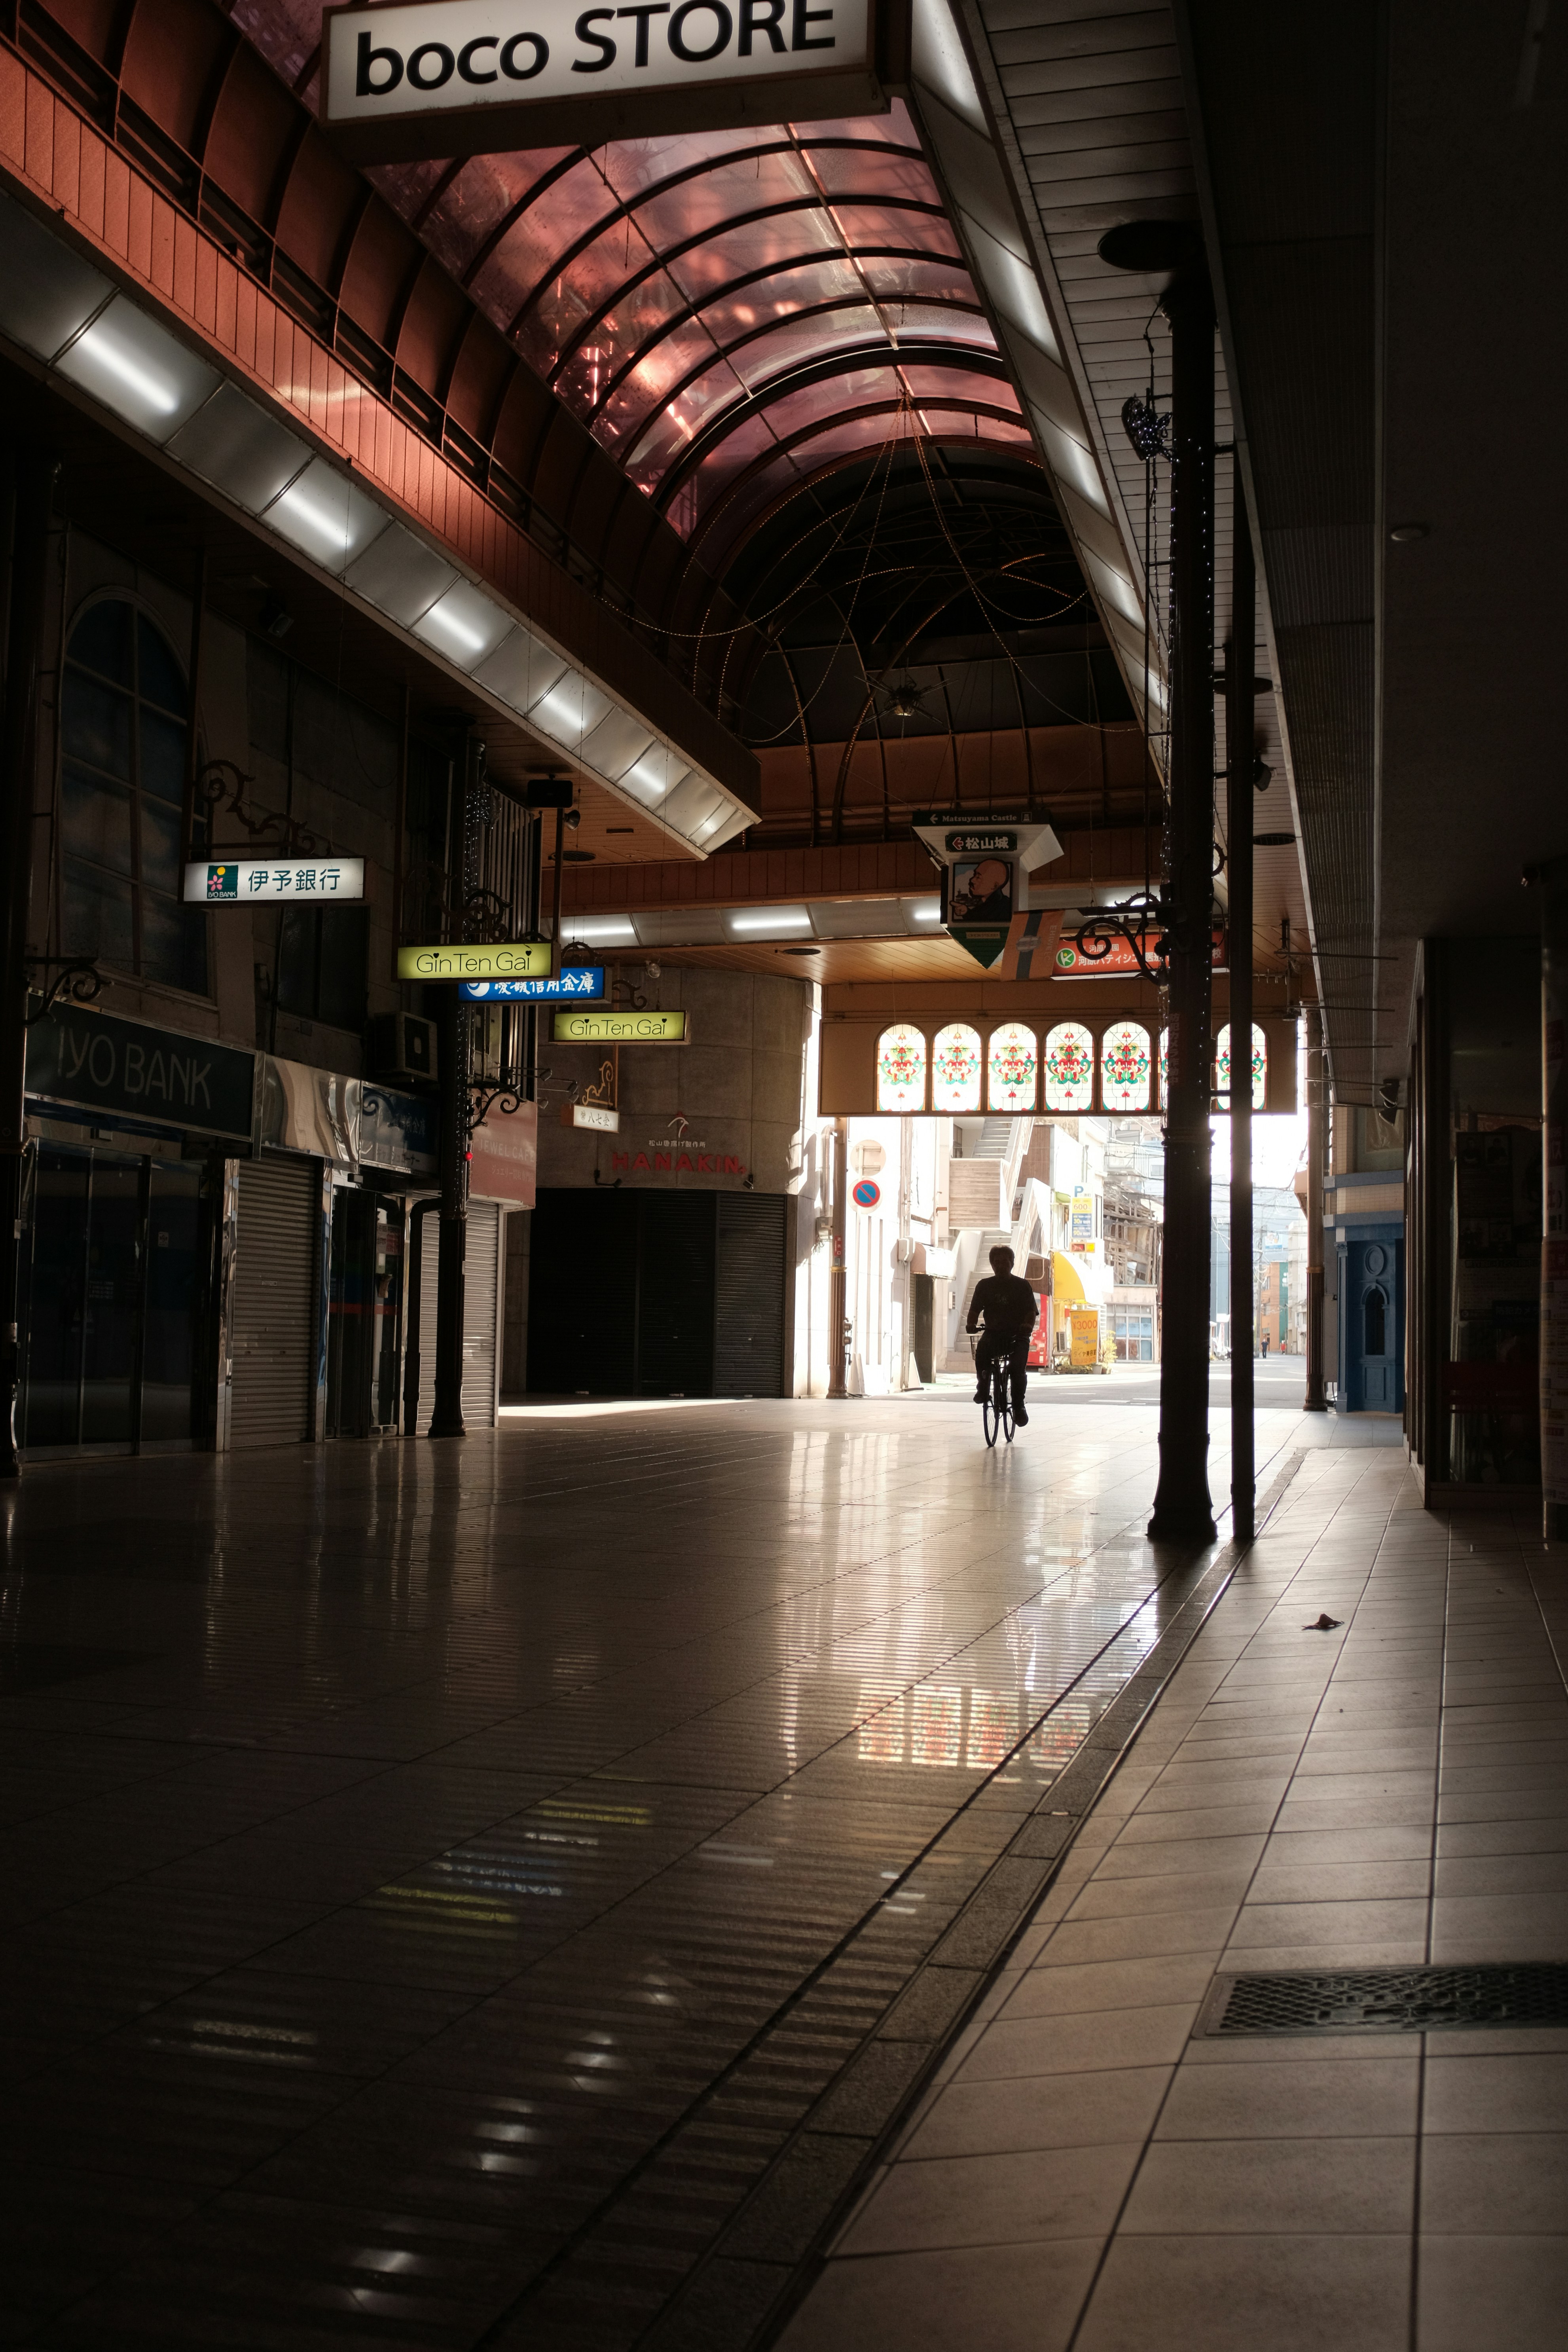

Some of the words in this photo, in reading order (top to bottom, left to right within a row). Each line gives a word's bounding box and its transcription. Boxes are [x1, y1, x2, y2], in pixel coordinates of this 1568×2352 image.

[356, 32, 549, 96] boco
[571, 0, 835, 73] STORE
[965, 836, 1009, 850] 松山城
[248, 869, 340, 892] 伊予銀行
[1089, 944, 1119, 953] 河原園
[57, 1026, 116, 1087] IYO
[124, 1042, 212, 1110] BANK
[478, 1138, 510, 1157] JEWEL
[648, 1140, 706, 1148] 松山唐揚げ製作所
[612, 1152, 739, 1174] HANAKIN
[1074, 1186, 1084, 1197] P
[1072, 1319, 1098, 1330] ¥3000
